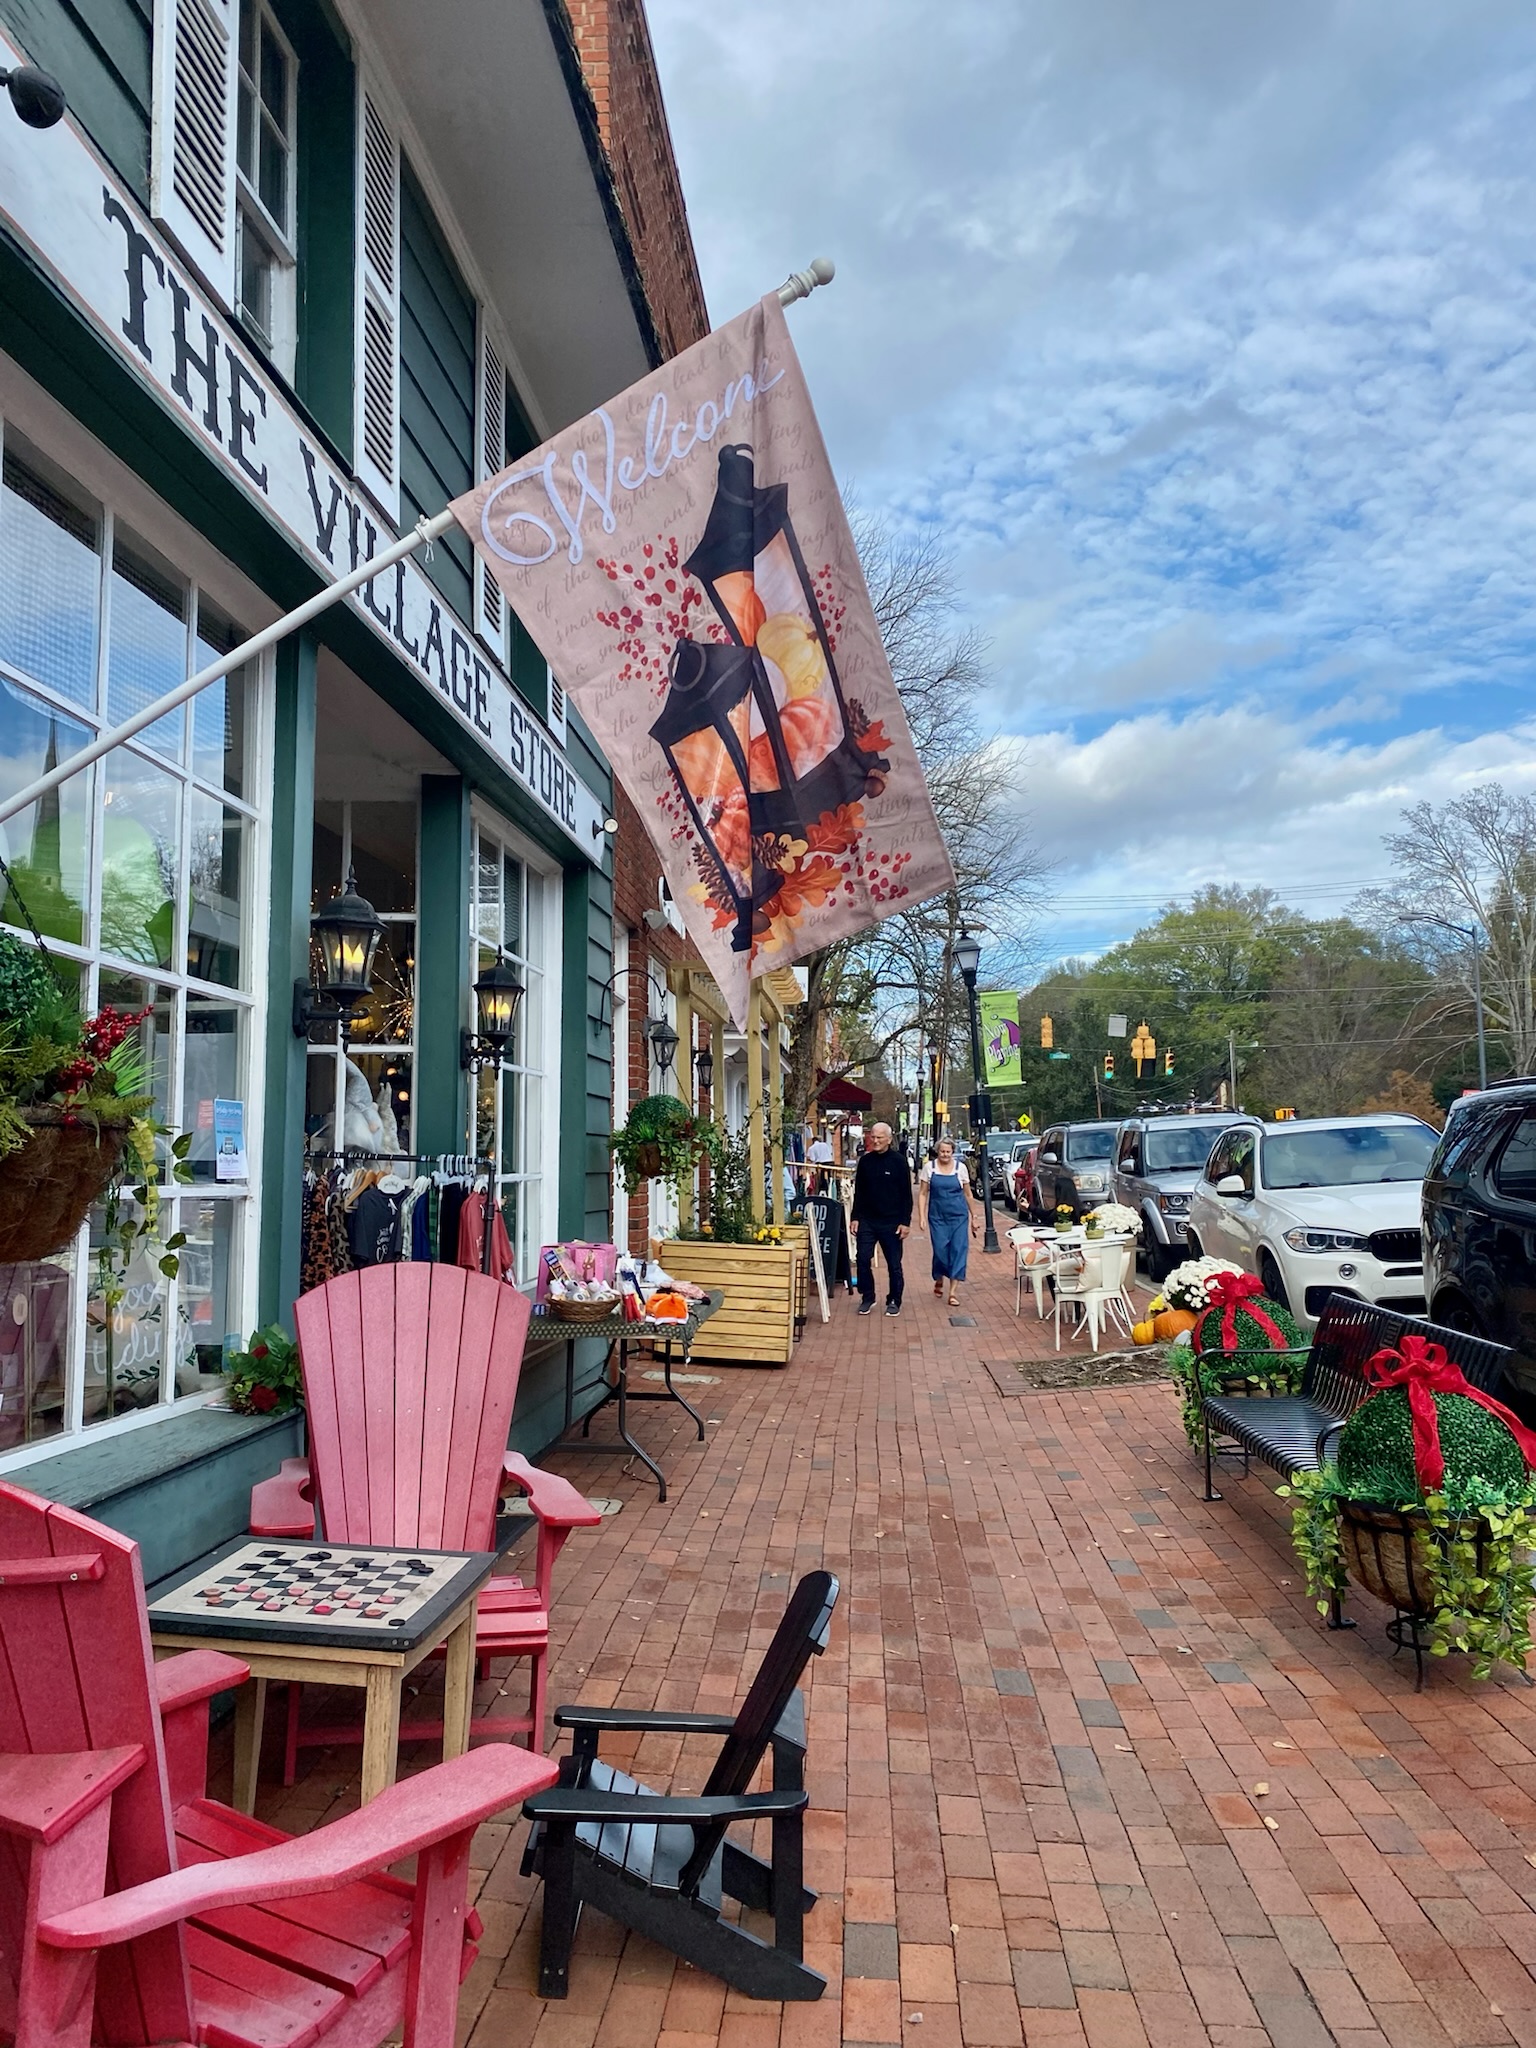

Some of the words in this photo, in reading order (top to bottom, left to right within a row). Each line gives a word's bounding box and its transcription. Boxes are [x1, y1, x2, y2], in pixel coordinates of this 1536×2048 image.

[103, 186, 268, 494] THE
[300, 441, 492, 738] VILLAGE
[508, 709, 577, 833] STORE
[564, 566, 591, 594] the
[663, 489, 697, 529] and
[609, 708, 639, 738] the
[983, 1022, 1007, 1041] Now
[987, 1043, 1020, 1066] Playing
